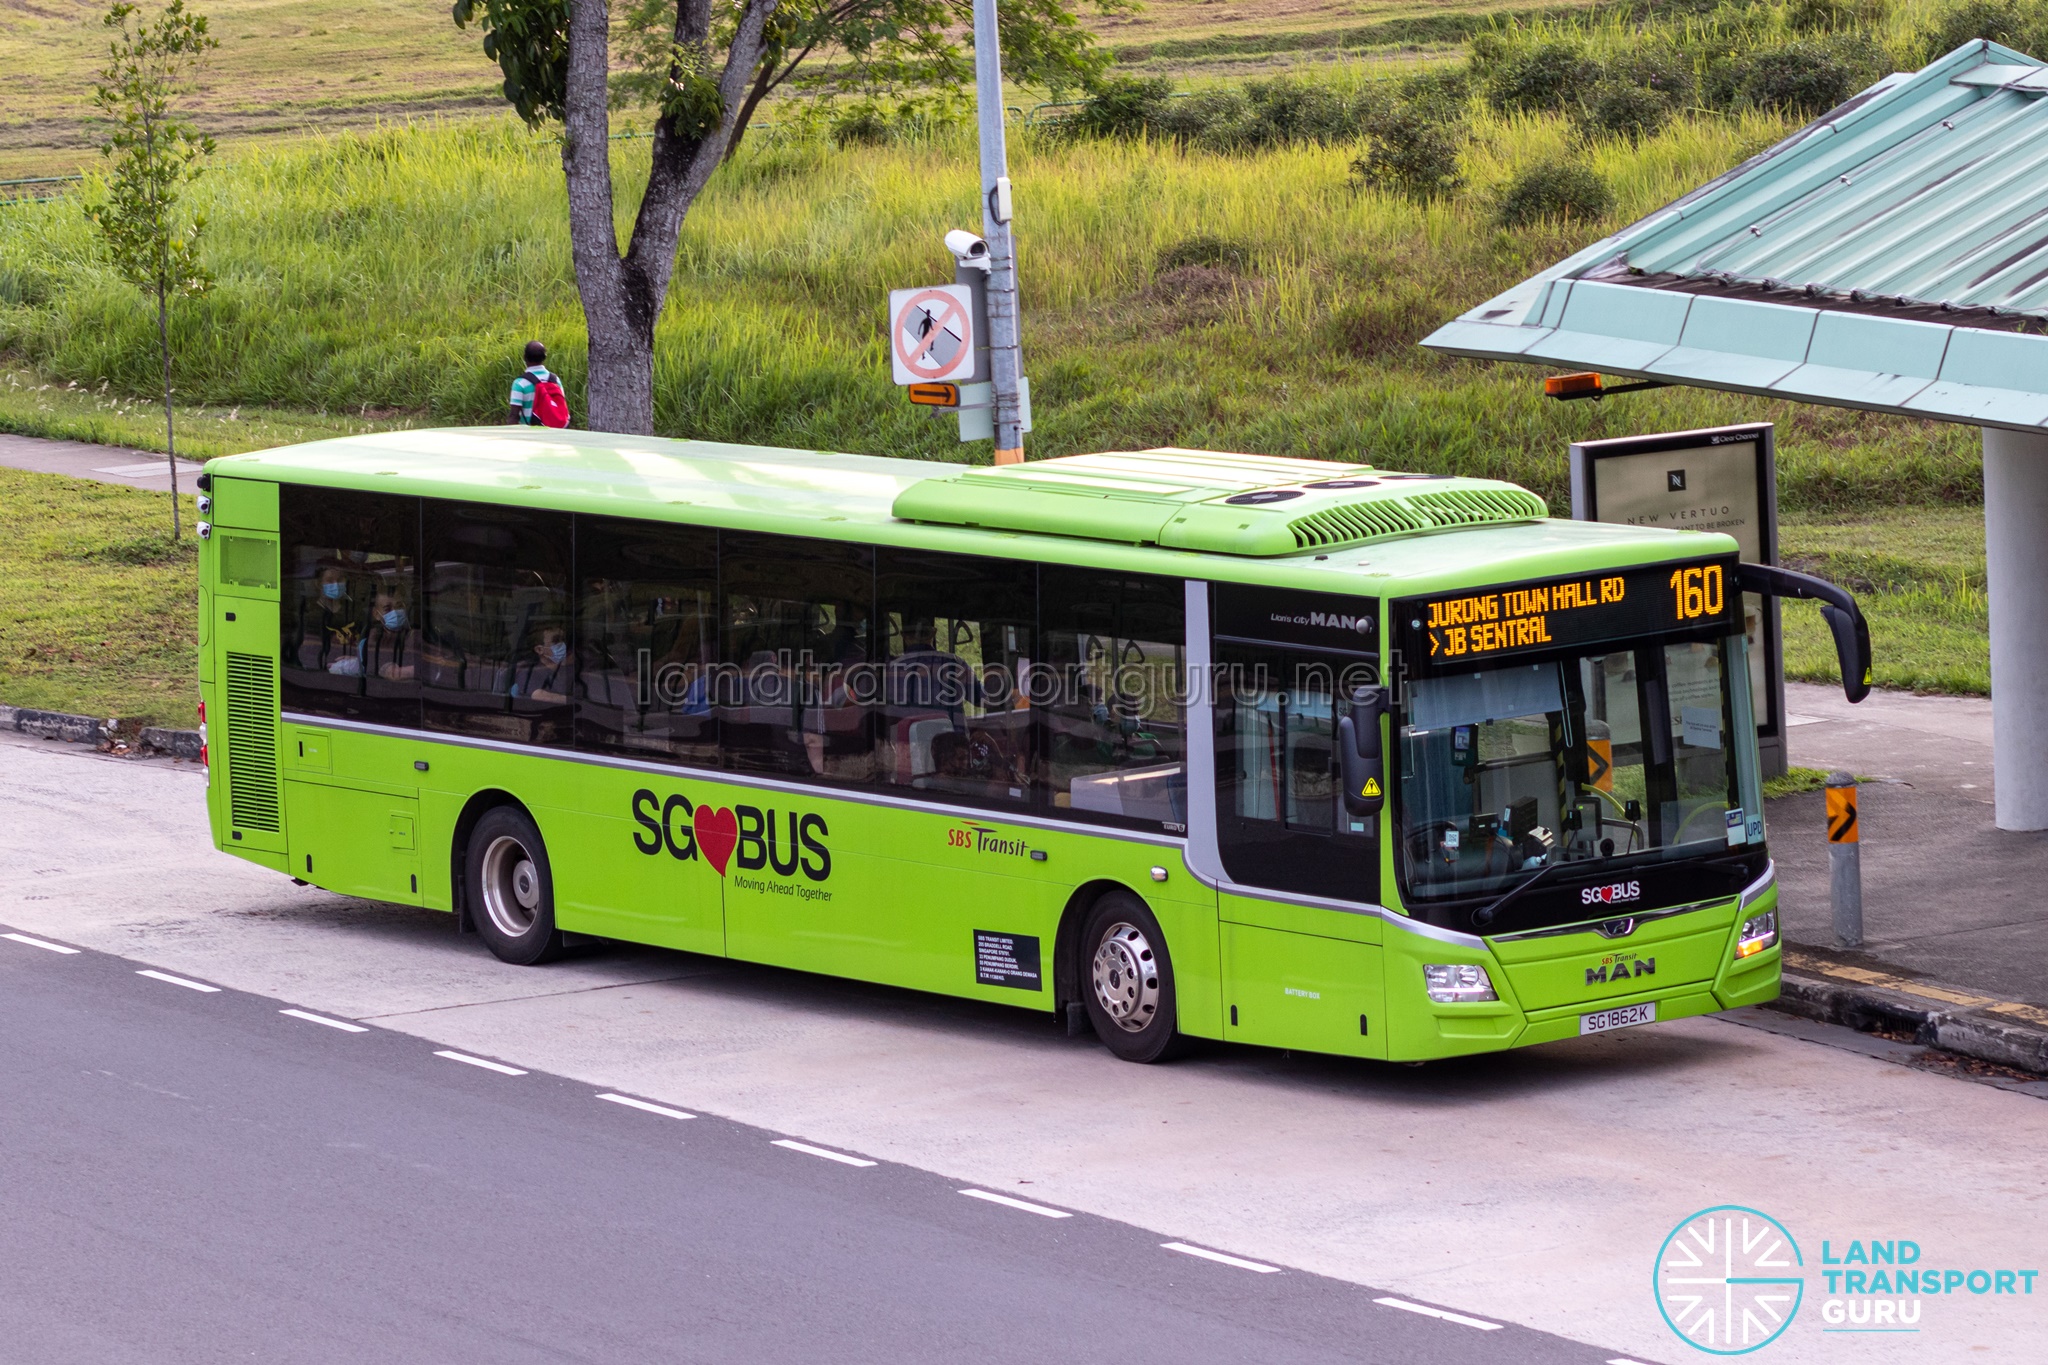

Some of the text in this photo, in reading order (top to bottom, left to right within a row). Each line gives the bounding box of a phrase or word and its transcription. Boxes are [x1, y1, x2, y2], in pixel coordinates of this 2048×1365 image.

[1627, 506, 1730, 525] NEW VERTUO
[1716, 518, 1745, 528] BROKEN
[1427, 577, 1625, 628] JURONG TOWN HALL RD
[1669, 564, 1724, 621] 160
[1293, 615, 1310, 626] City
[1310, 611, 1356, 630] MAN
[1444, 616, 1552, 656] JB SENTRAL
[631, 788, 832, 882] SG BUS
[1747, 820, 1762, 837] UPD
[947, 827, 1030, 857] SBS Transit
[734, 875, 833, 902] Moving Ahead Together
[1581, 888, 1601, 905] SG
[1612, 880, 1641, 900] BUS
[1585, 957, 1656, 986] MAN
[1601, 953, 1638, 965] SBS Transit
[1284, 987, 1321, 1000] BATTERY BOX
[1588, 1005, 1648, 1031] SG1862K
